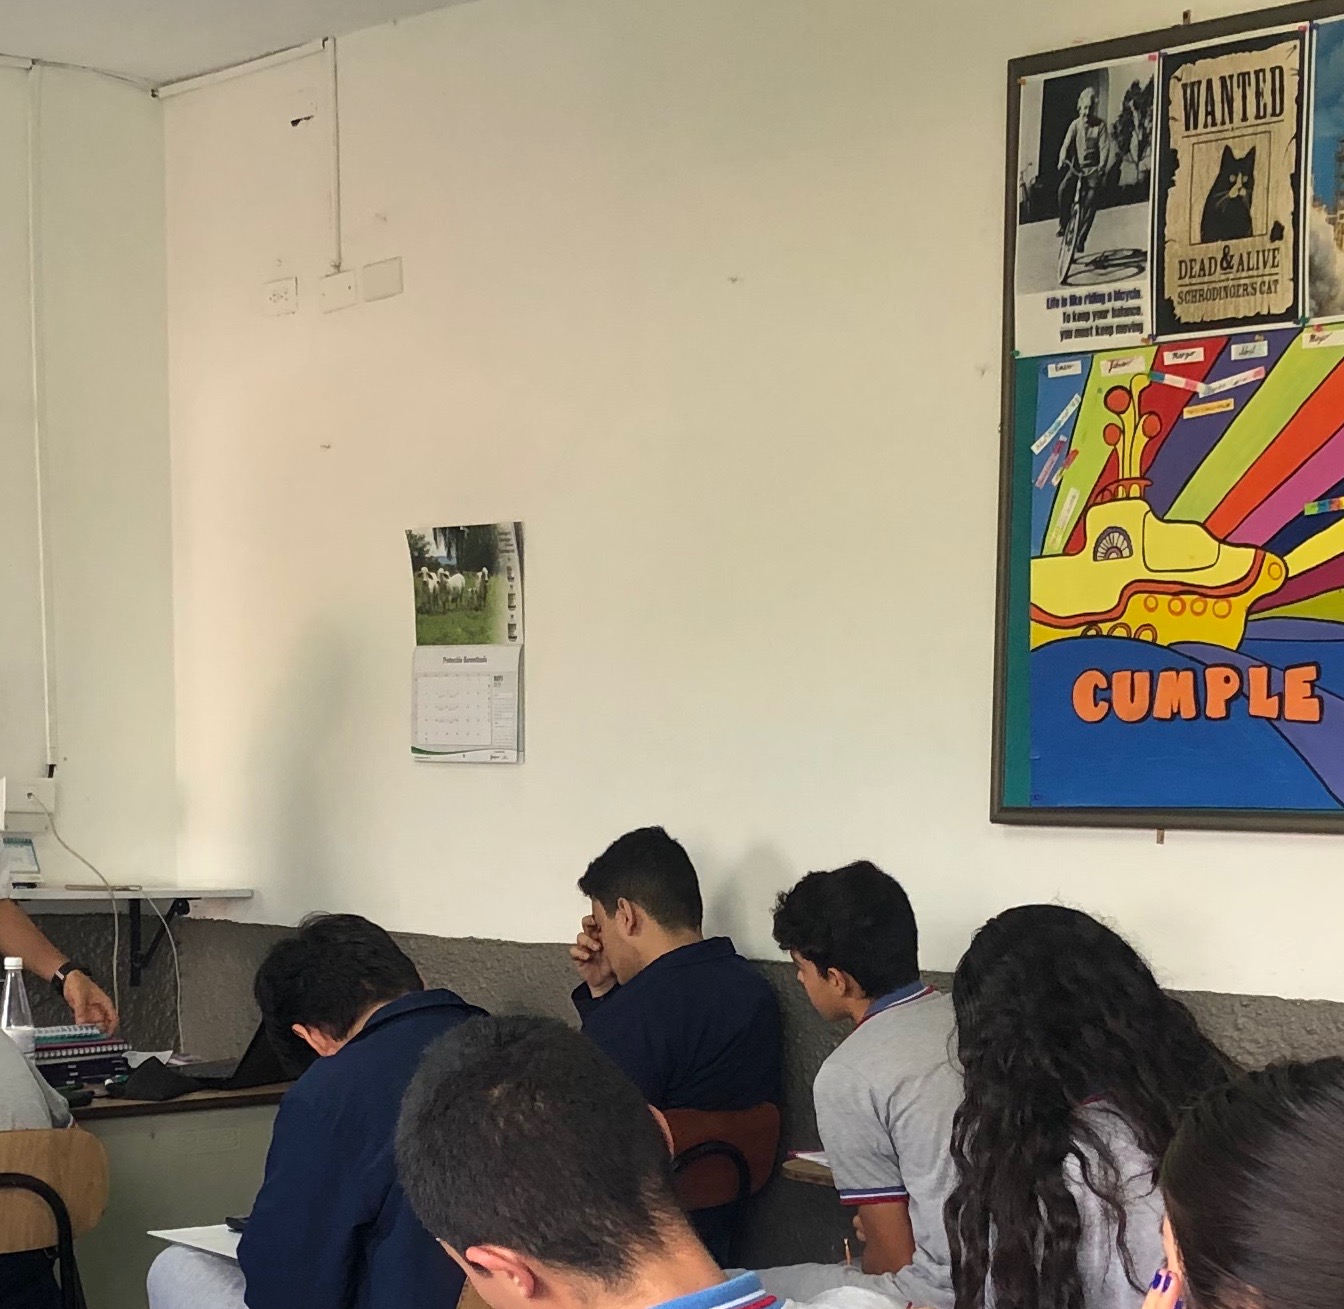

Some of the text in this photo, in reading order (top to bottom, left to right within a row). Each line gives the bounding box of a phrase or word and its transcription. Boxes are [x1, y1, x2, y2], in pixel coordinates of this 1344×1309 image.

[1181, 65, 1285, 132] WANTED
[1177, 245, 1280, 280] DEAD & ALIVE
[1259, 279, 1279, 295] CAT
[1071, 662, 1324, 724] CUMPLE
